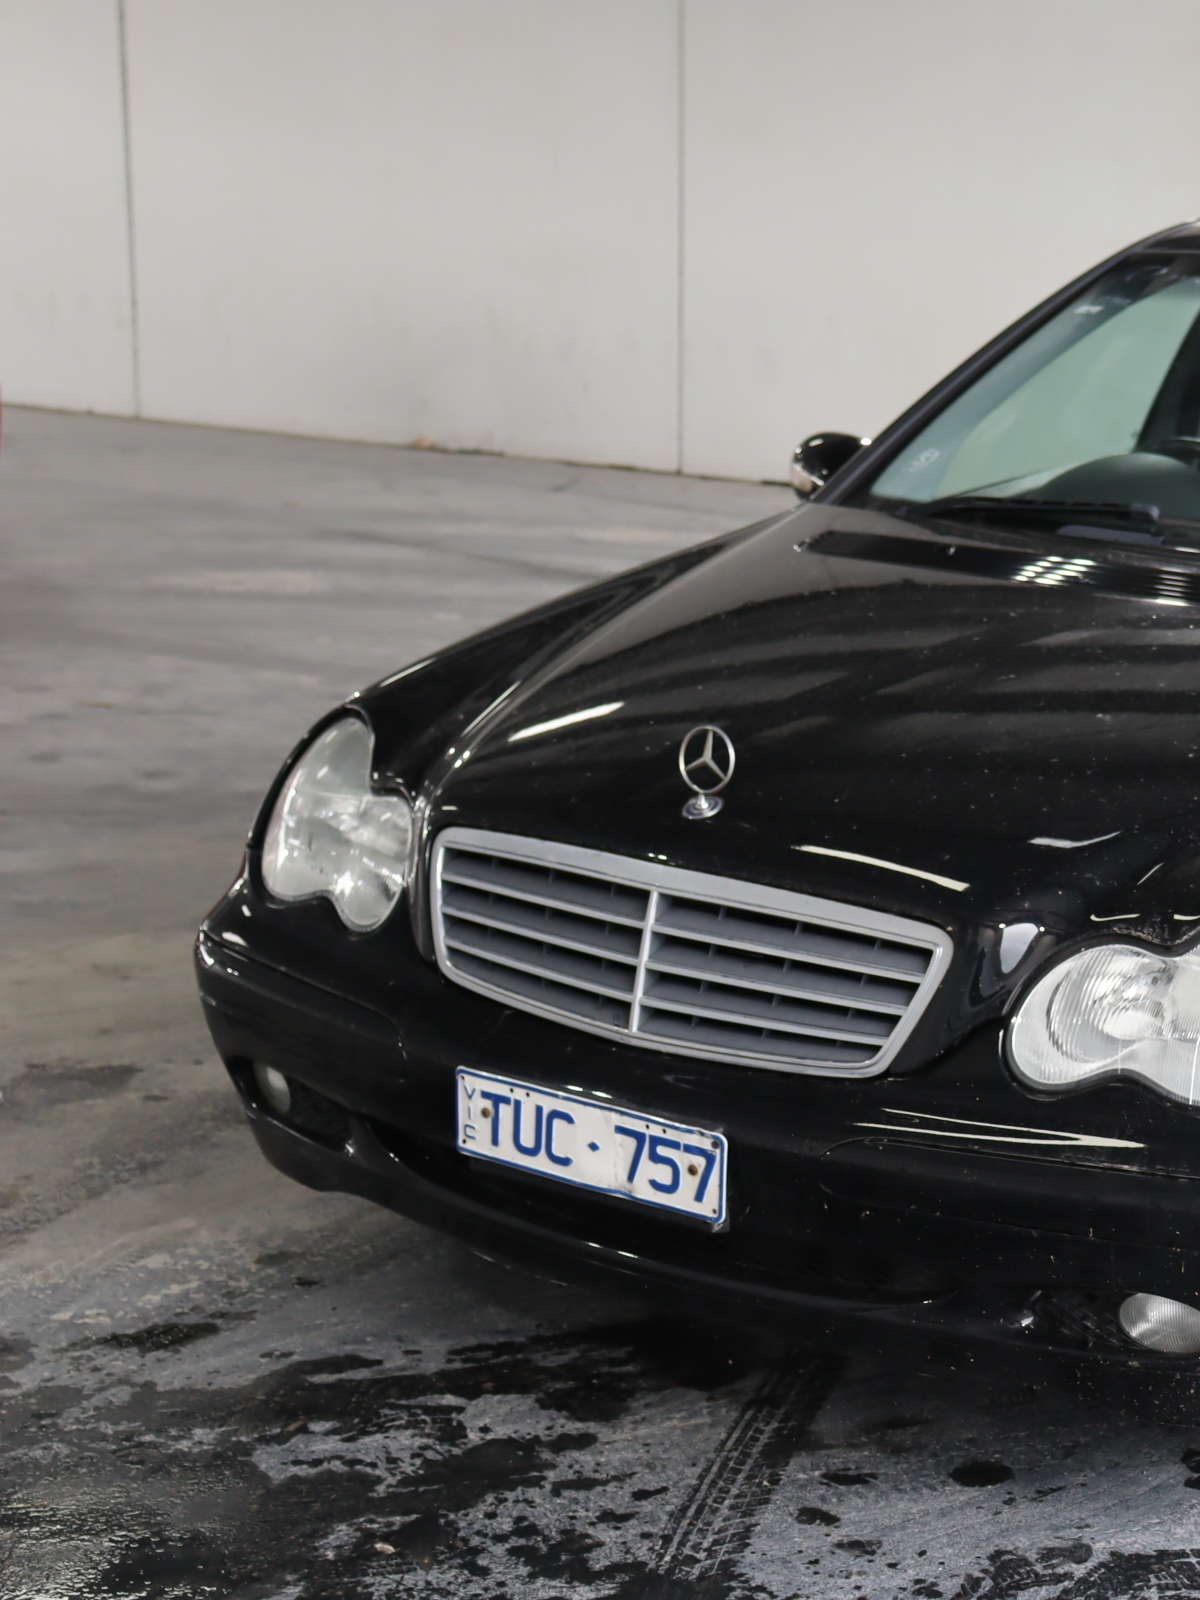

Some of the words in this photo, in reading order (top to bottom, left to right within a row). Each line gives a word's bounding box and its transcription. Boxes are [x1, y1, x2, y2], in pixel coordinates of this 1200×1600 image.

[463, 1084, 478, 1141] VIC
[480, 1089, 576, 1168] TUC
[614, 1124, 717, 1204] 757
